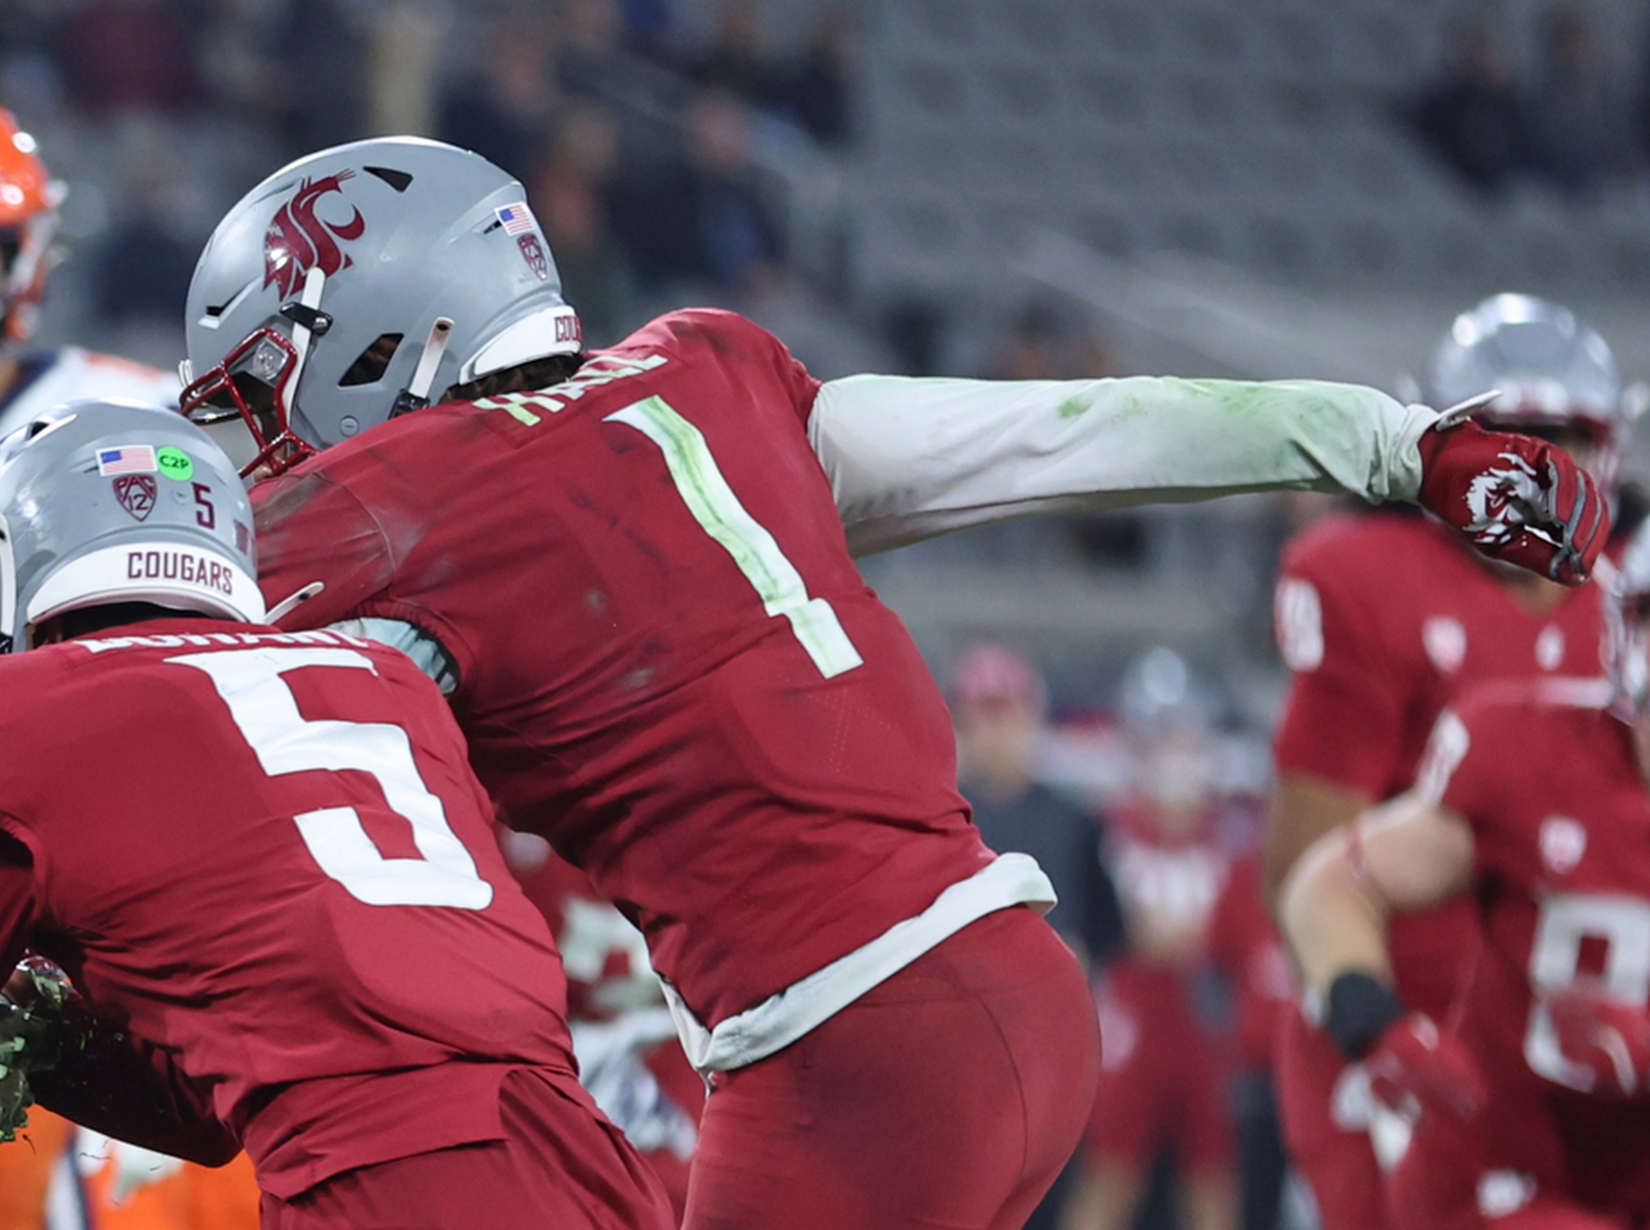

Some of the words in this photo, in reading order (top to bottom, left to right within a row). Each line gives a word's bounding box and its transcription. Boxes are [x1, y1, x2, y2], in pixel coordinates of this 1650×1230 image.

[128, 493, 149, 512] 12
[191, 481, 215, 530] 5
[601, 394, 865, 680] 1
[127, 551, 233, 595] COUGARS
[162, 646, 494, 912] 5
